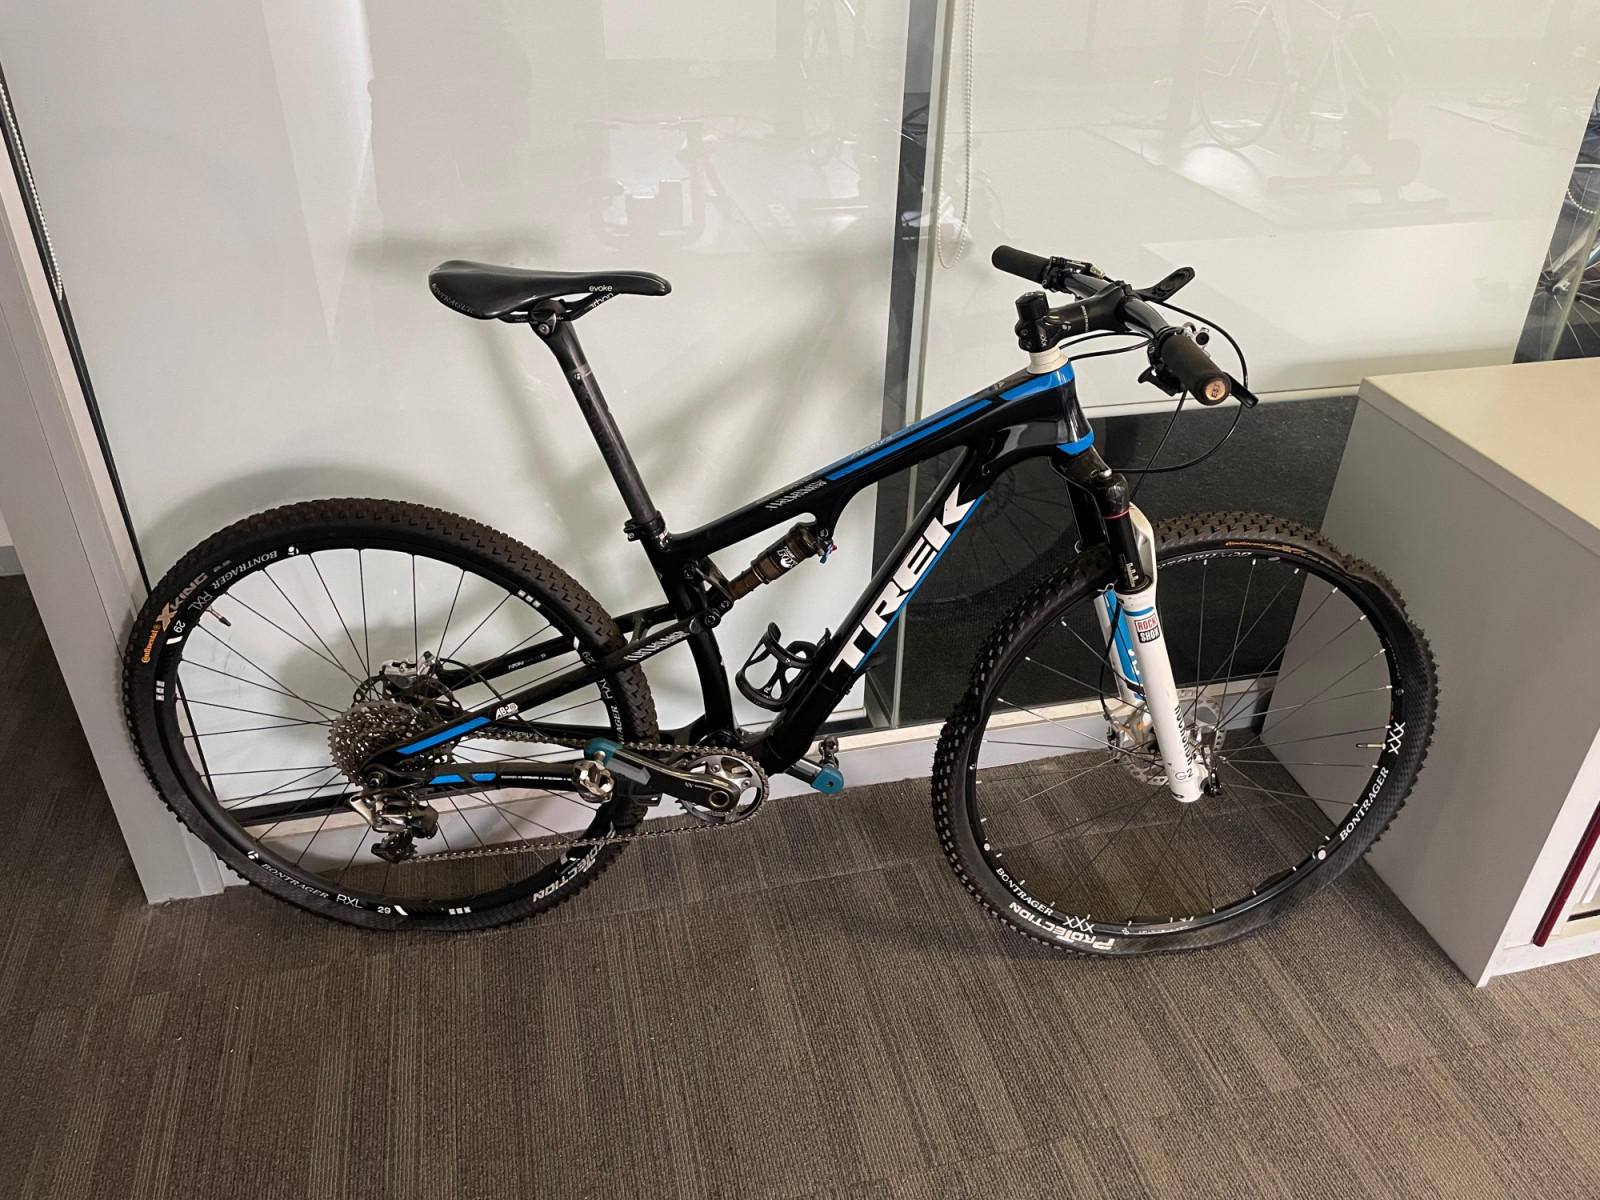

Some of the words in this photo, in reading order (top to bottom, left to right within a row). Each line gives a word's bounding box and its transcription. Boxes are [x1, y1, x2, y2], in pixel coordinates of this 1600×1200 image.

[211, 550, 278, 590] BONTRAGER
[829, 482, 976, 673] TREK
[173, 620, 186, 633] 29
[1339, 766, 1389, 841] BONTRAGER
[261, 863, 330, 898] BONTRAGER
[336, 893, 363, 908] RXL
[377, 906, 391, 914] 29
[996, 867, 1054, 917] BONTRAGER
[1008, 901, 1116, 951] PROTECTION
